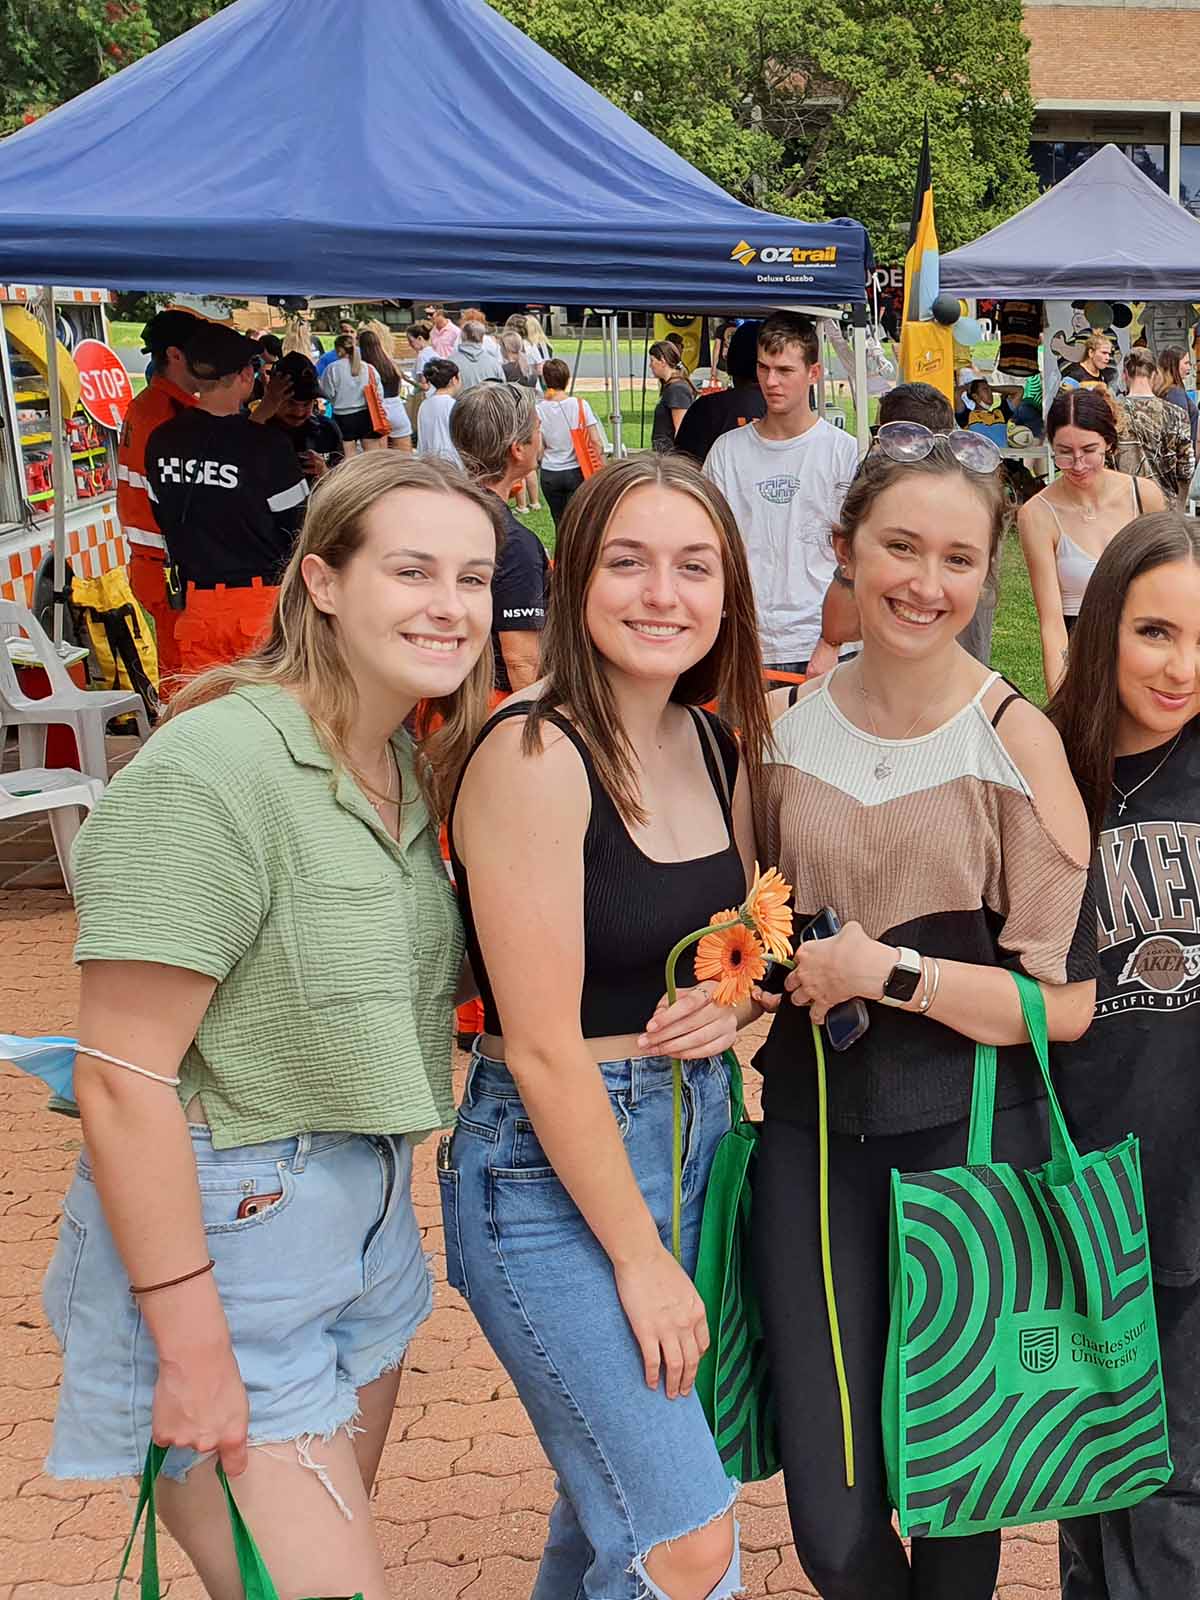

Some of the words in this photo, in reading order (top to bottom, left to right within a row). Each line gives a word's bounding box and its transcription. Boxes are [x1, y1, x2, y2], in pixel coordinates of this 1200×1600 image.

[759, 246, 837, 263] OZtrail
[757, 274, 784, 283] Deluxe
[785, 275, 814, 283] Gazebo
[80, 368, 125, 400] STOP
[1071, 1332, 1122, 1354] Charles
[1071, 1346, 1138, 1369] University
